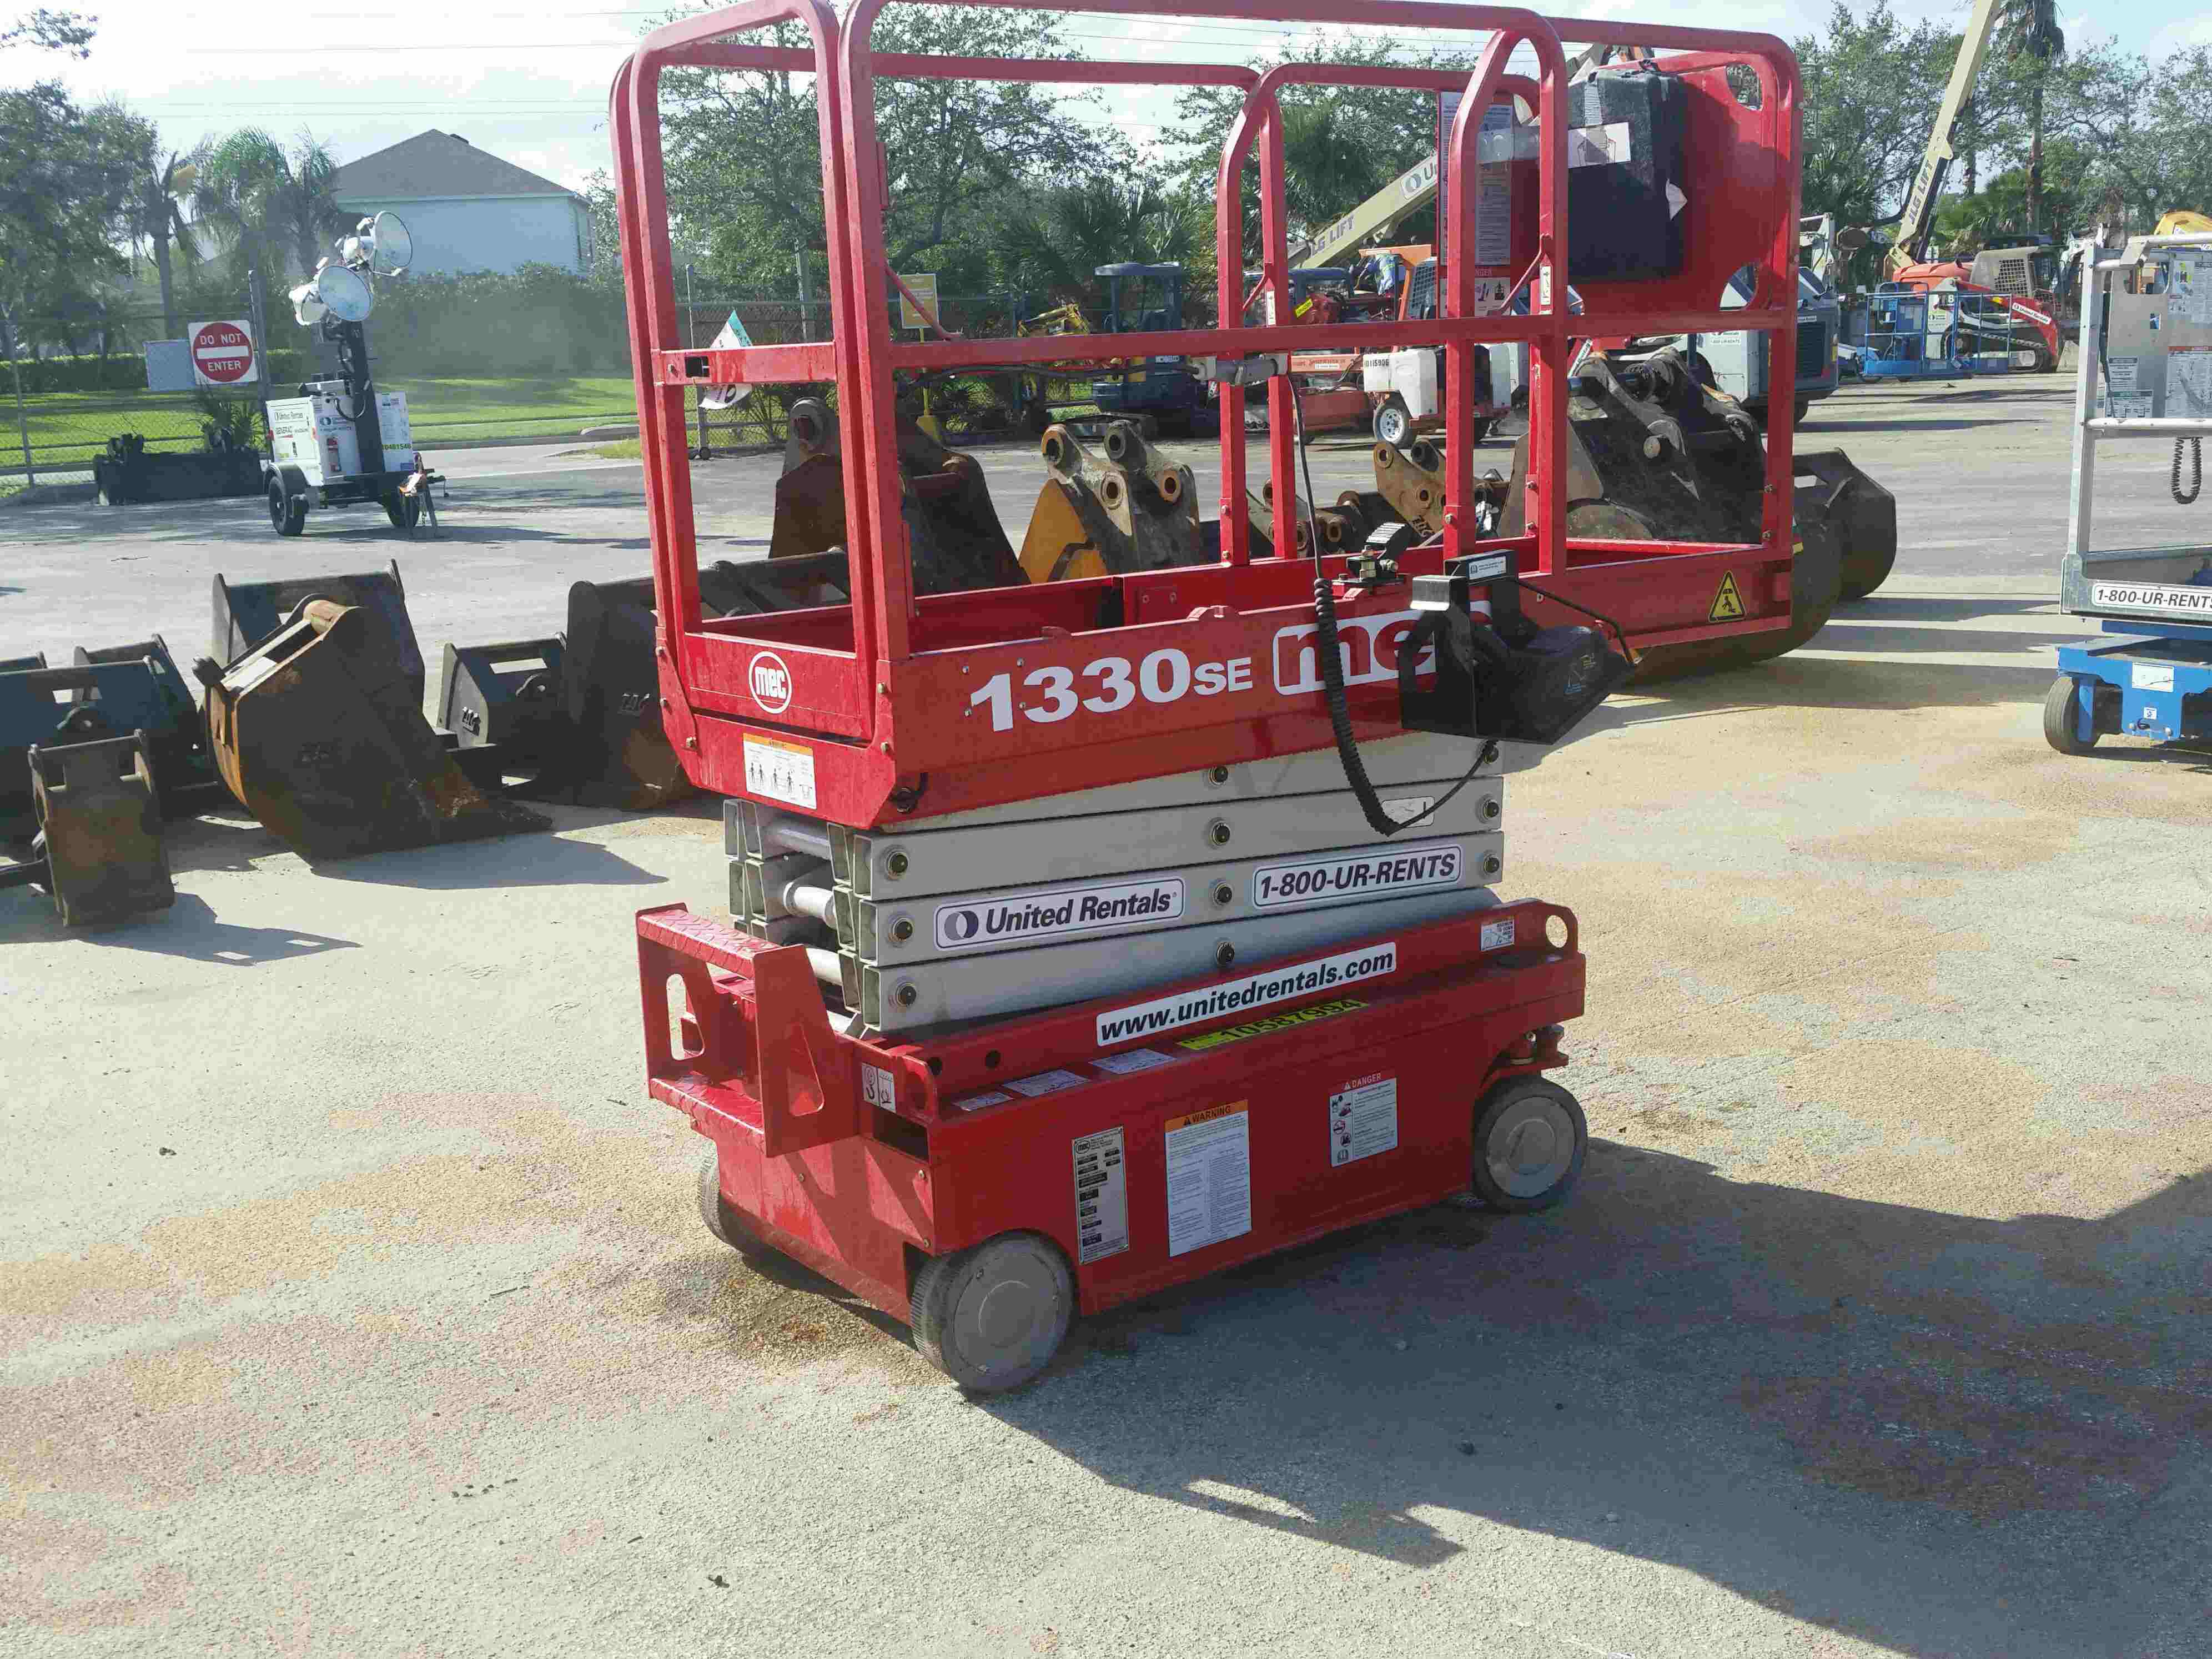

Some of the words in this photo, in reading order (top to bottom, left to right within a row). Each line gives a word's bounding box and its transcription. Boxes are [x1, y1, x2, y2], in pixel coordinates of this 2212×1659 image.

[1330, 214, 1354, 242] LIFT
[199, 335, 214, 345] DO
[220, 333, 242, 344] NOT
[207, 360, 242, 371] ENTER
[1260, 853, 1456, 899] 1-800-UR-RENTS
[986, 898, 1074, 934] United
[1079, 888, 1171, 922] Rentals
[1100, 953, 1392, 1040] www.unitedrentals.com
[1352, 1072, 1381, 1088] DANGER
[1192, 1105, 1231, 1123] WARNING
